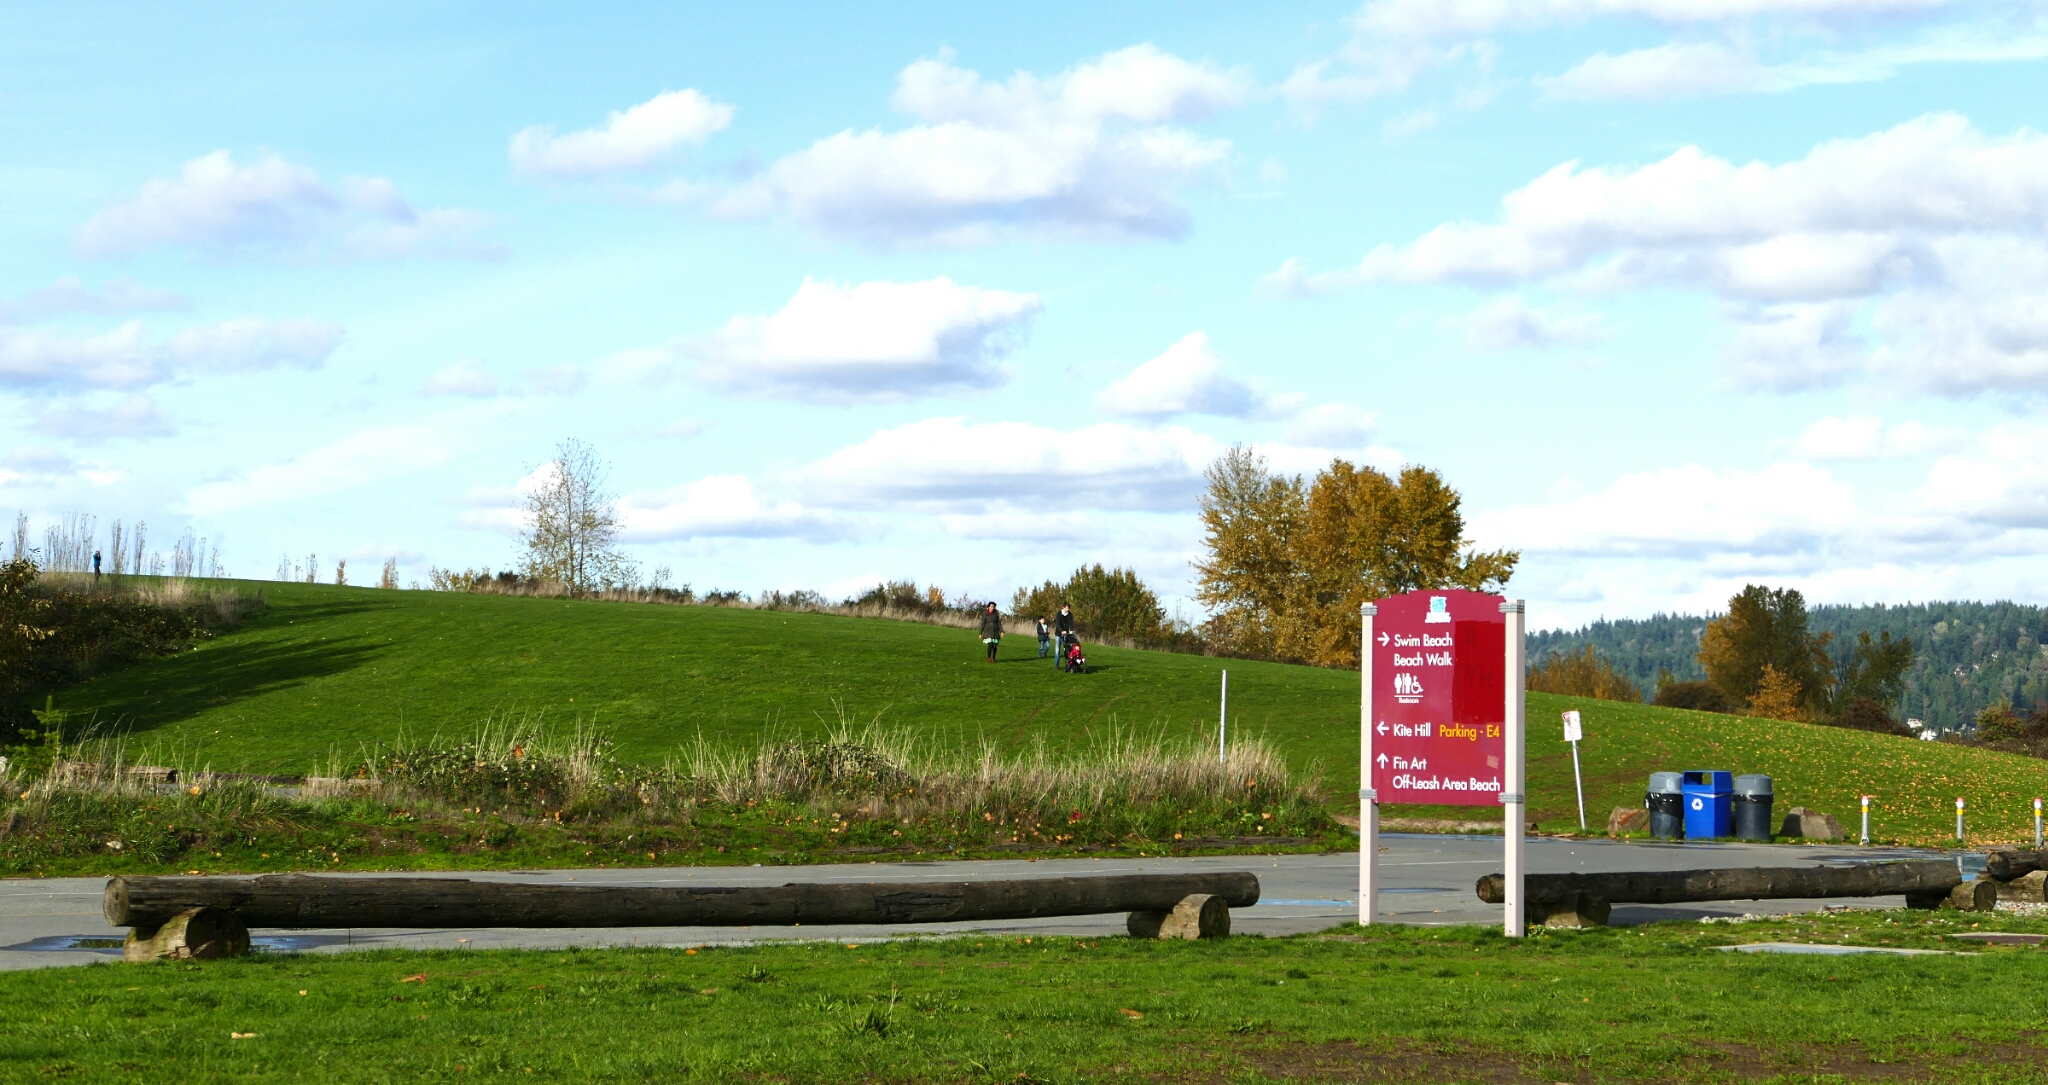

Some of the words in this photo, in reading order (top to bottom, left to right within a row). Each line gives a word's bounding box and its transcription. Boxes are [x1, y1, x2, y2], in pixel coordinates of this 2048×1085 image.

[1394, 634, 1420, 647] Swim
[1423, 632, 1453, 646] Beach
[1394, 652, 1423, 666] Beach
[1426, 652, 1452, 666] Walk
[1394, 723, 1412, 737] Kite
[1415, 723, 1431, 737] Hill
[1440, 723, 1477, 741] Parking
[1486, 725, 1500, 737] E4
[1393, 756, 1408, 769] Fin
[1410, 757, 1427, 770] Art
[1393, 774, 1440, 790] Off-Leash
[1442, 777, 1468, 790] Area
[1470, 776, 1501, 791] Beach
